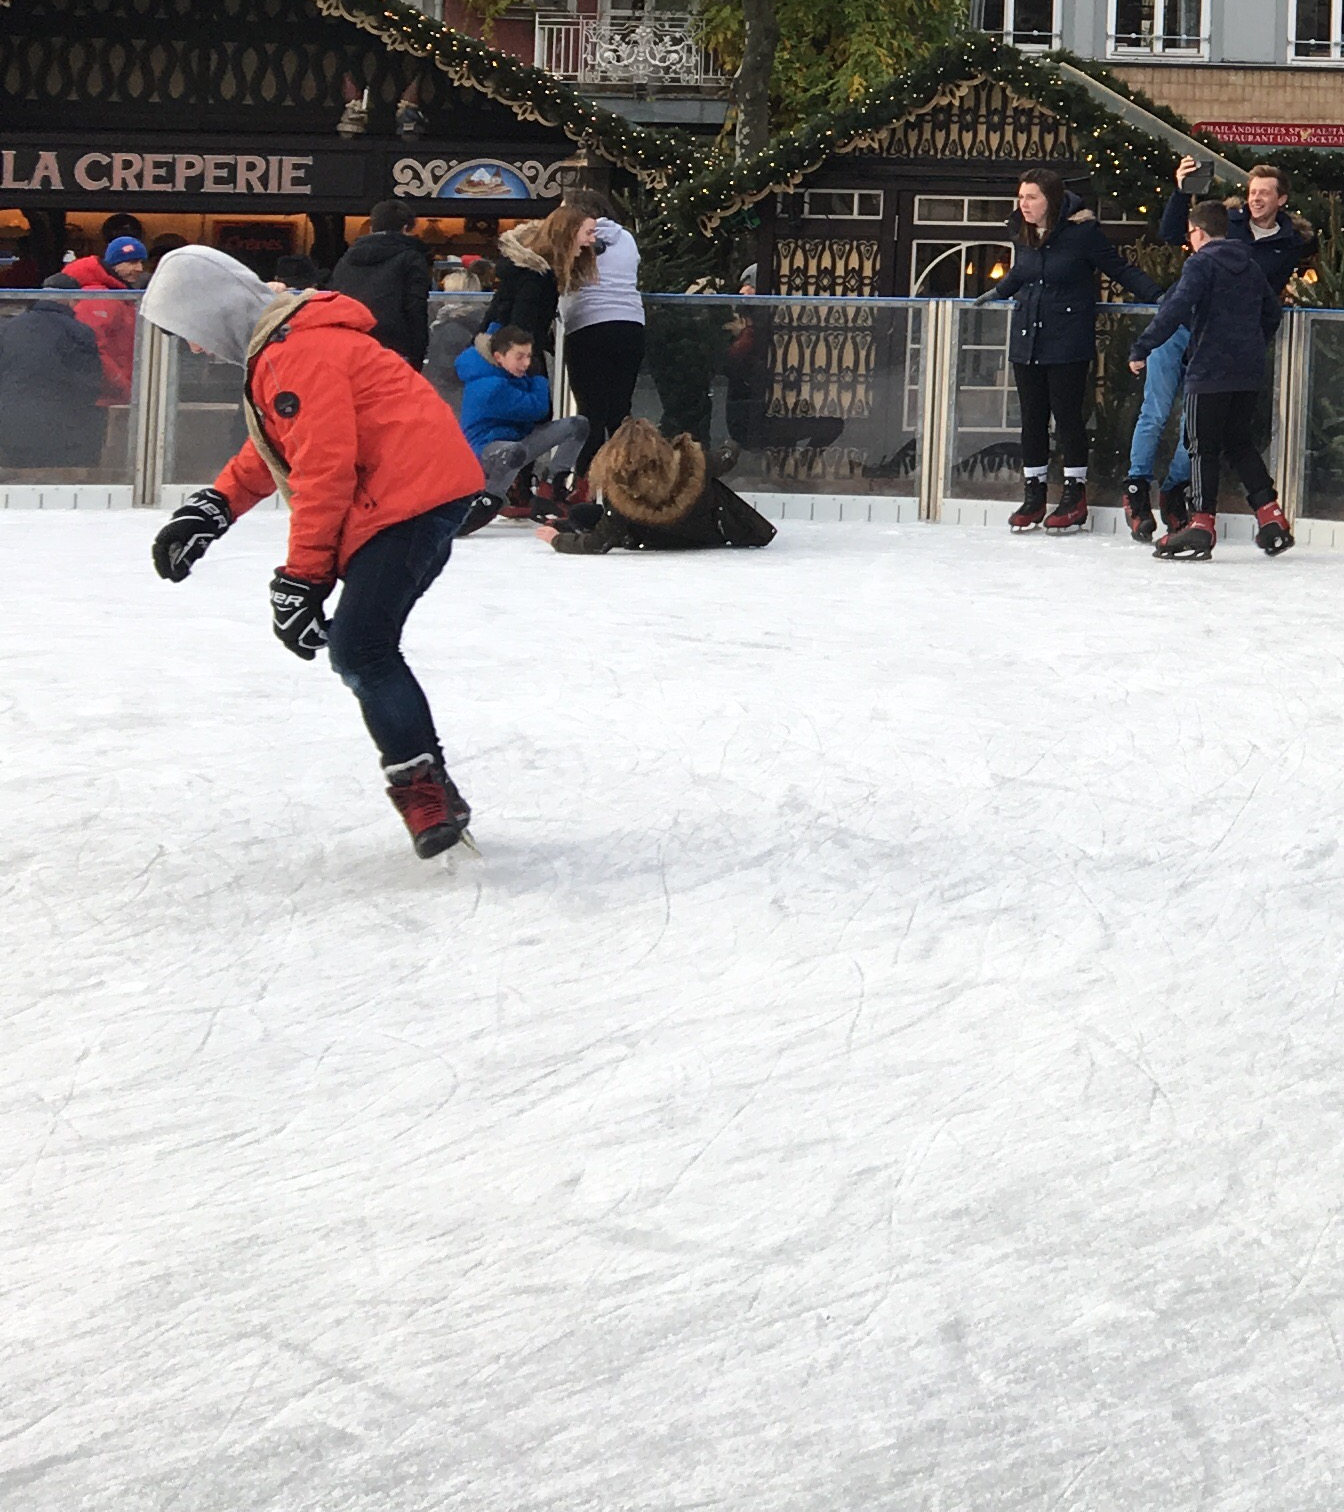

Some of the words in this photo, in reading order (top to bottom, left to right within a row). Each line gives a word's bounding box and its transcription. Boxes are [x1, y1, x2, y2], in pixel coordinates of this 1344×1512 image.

[1214, 133, 1274, 143] ESTAURANT
[1277, 135, 1299, 144] UND
[1, 150, 64, 190] LA
[73, 152, 314, 194] CREPERIE
